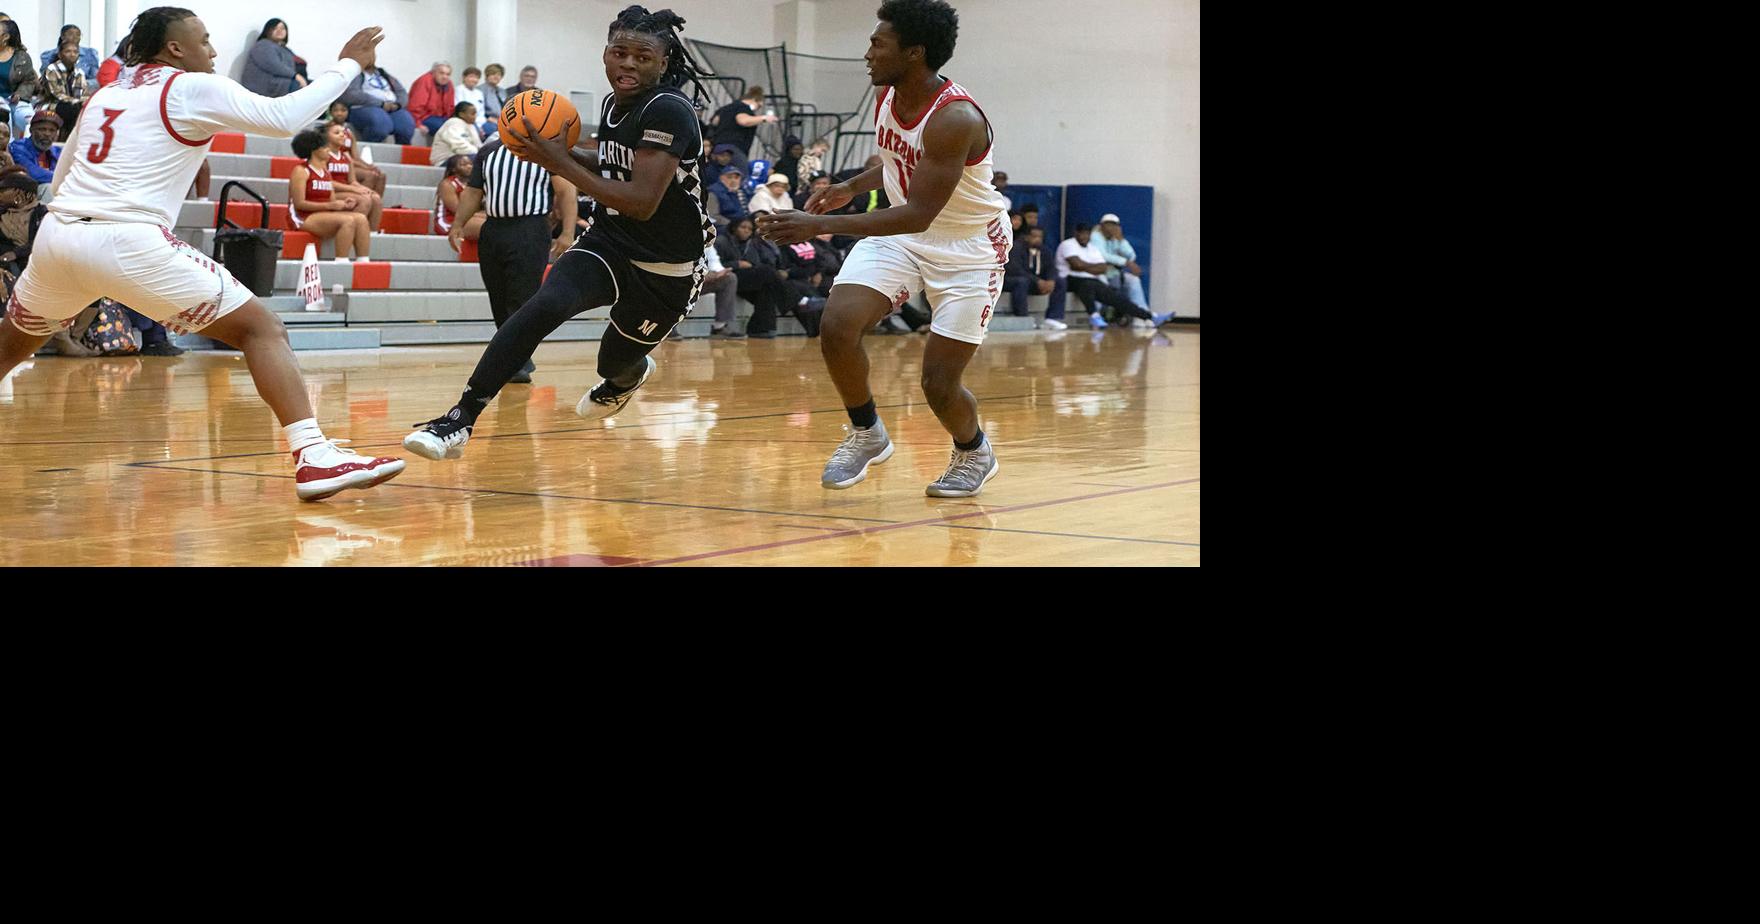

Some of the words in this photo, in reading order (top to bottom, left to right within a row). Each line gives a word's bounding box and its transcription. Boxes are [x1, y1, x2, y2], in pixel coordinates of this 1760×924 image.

[86, 107, 127, 165] 3
[598, 140, 637, 171] ARTIN
[637, 319, 659, 337] M
